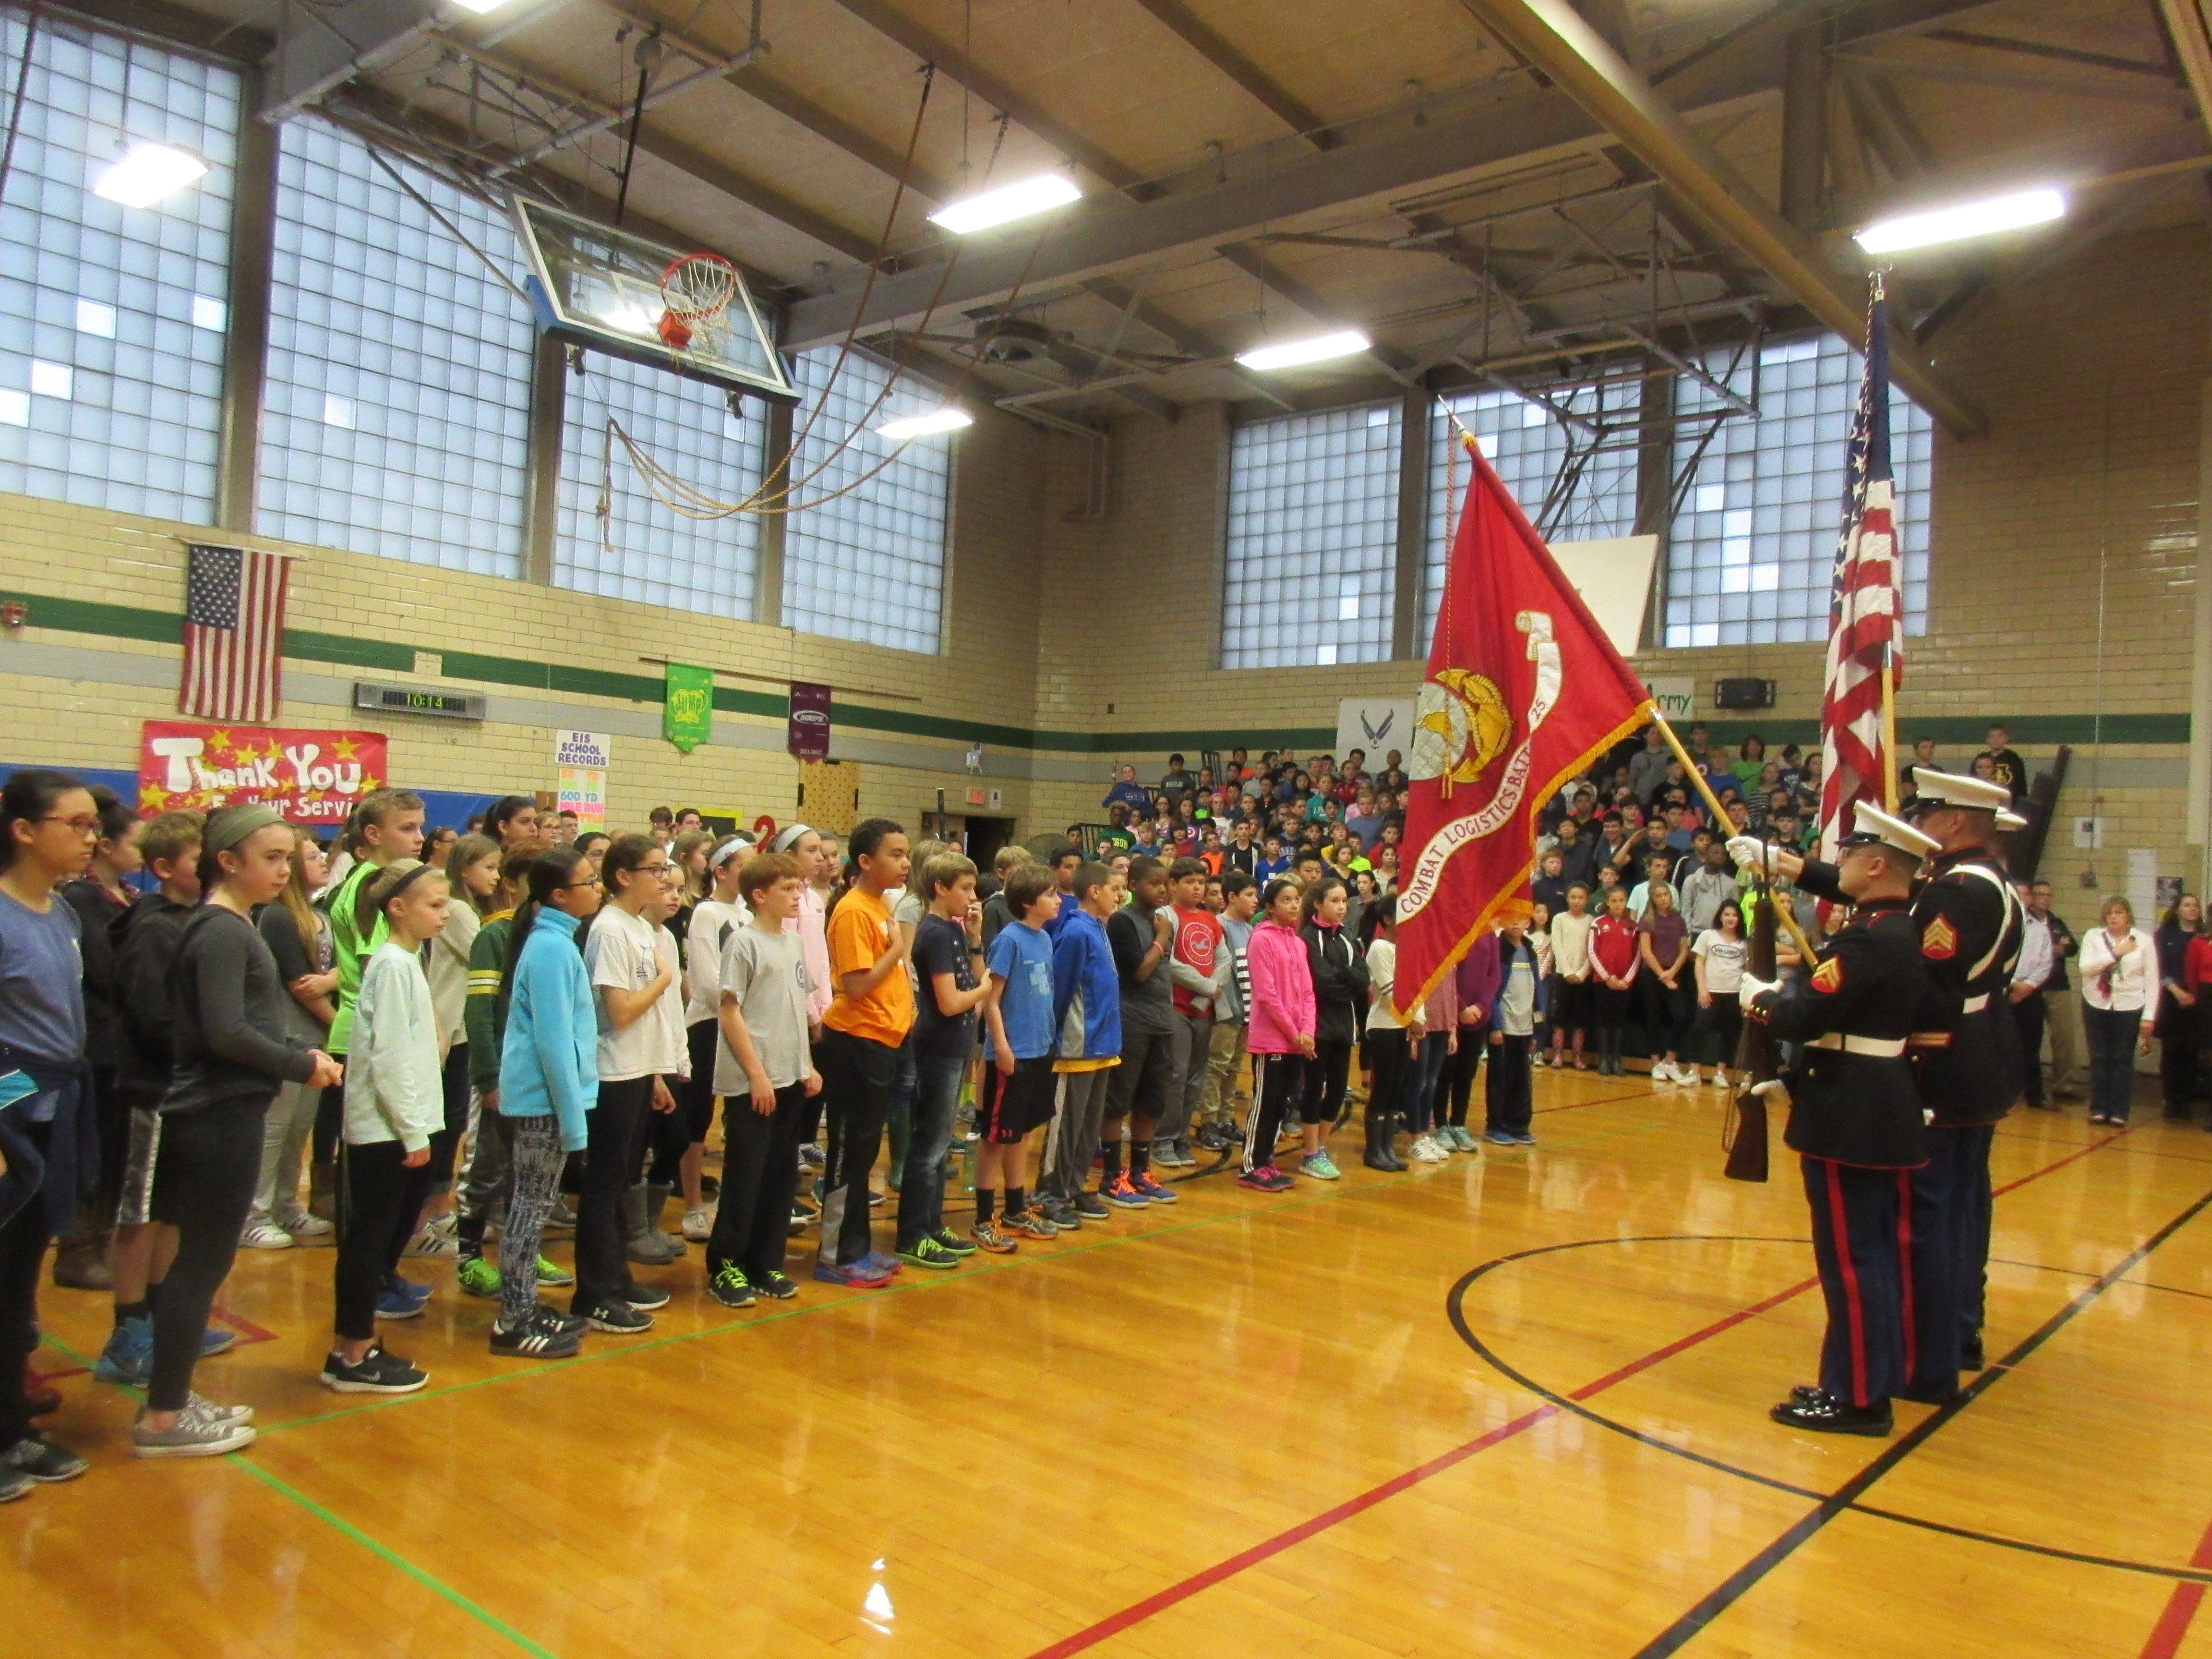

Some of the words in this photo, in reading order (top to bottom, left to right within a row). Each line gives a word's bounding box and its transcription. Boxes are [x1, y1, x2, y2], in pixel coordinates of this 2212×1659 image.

[408, 693, 443, 709] 10:14
[1647, 683, 1691, 716] rmy
[572, 732, 591, 744] EIS
[561, 742, 601, 756] SCHOOL
[558, 752, 607, 767] RECORDS
[560, 791, 580, 801] 600
[586, 793, 598, 803] YD
[294, 797, 353, 817] Servi
[1401, 844, 1444, 914] COMBAT
[1443, 788, 1517, 845] LOGISTICS
[1507, 746, 1530, 787] BATT
[1531, 698, 1546, 721] 25
